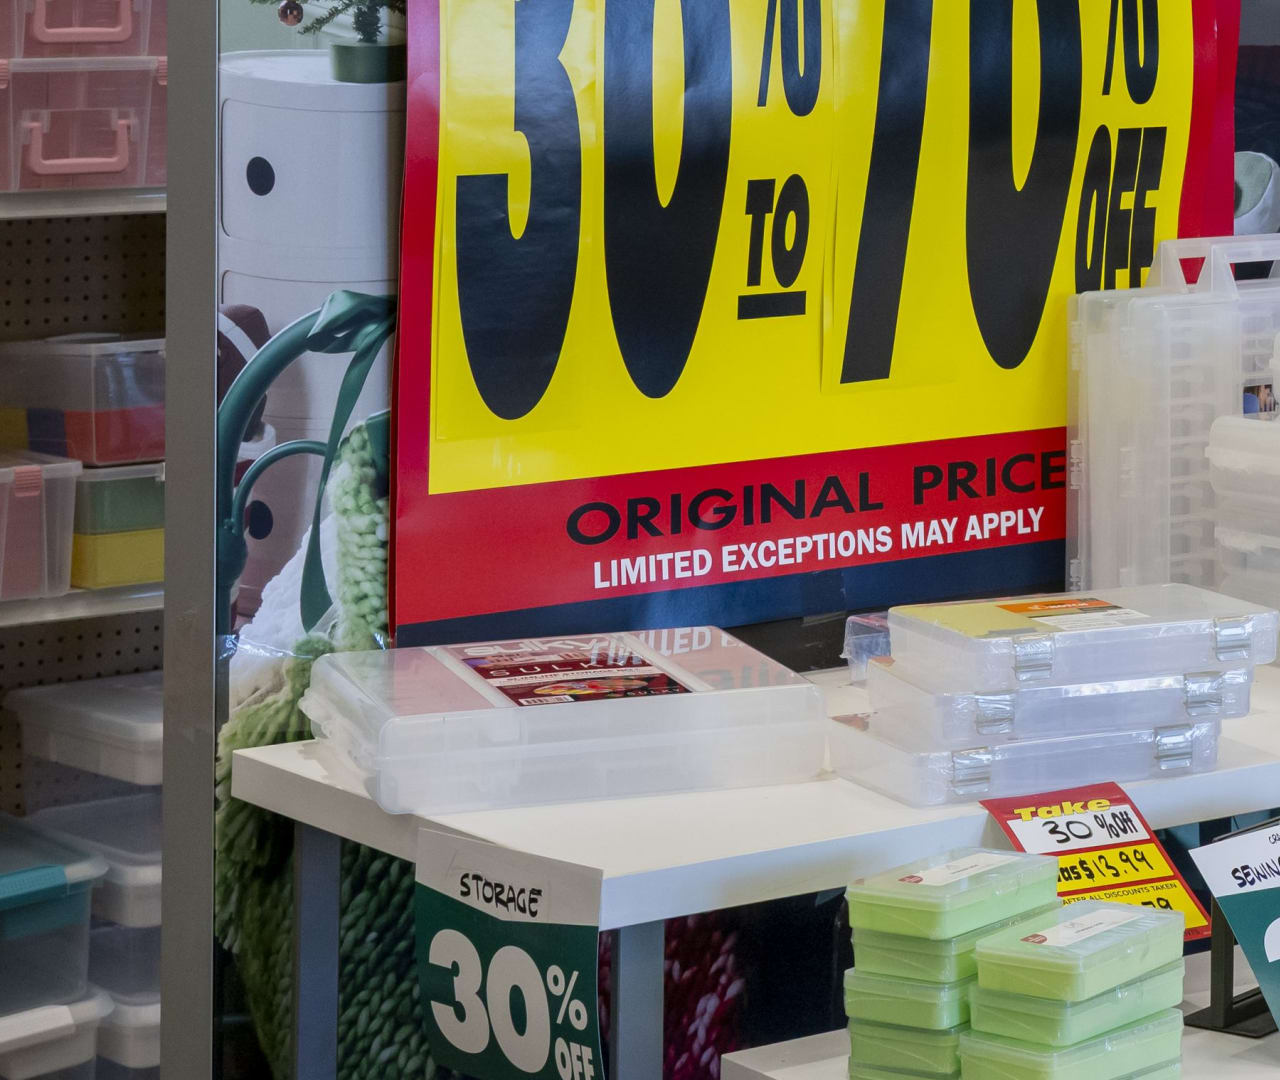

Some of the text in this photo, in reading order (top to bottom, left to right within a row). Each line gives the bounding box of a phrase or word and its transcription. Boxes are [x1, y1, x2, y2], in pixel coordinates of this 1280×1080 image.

[1075, 124, 1167, 294] OFF
[566, 450, 1066, 546] ORIGINAL PRICE
[594, 506, 1045, 589] LIMITED EXCEPTIONS MAY APPLY
[1014, 798, 1111, 822] Take
[1042, 810, 1138, 844] 30 %Off
[459, 873, 542, 917] STORAGE
[1057, 866, 1081, 883] as
[1105, 886, 1150, 899] DISCOUNTS
[1150, 883, 1178, 894] TAKEN
[428, 928, 595, 1080] 30% OFF
